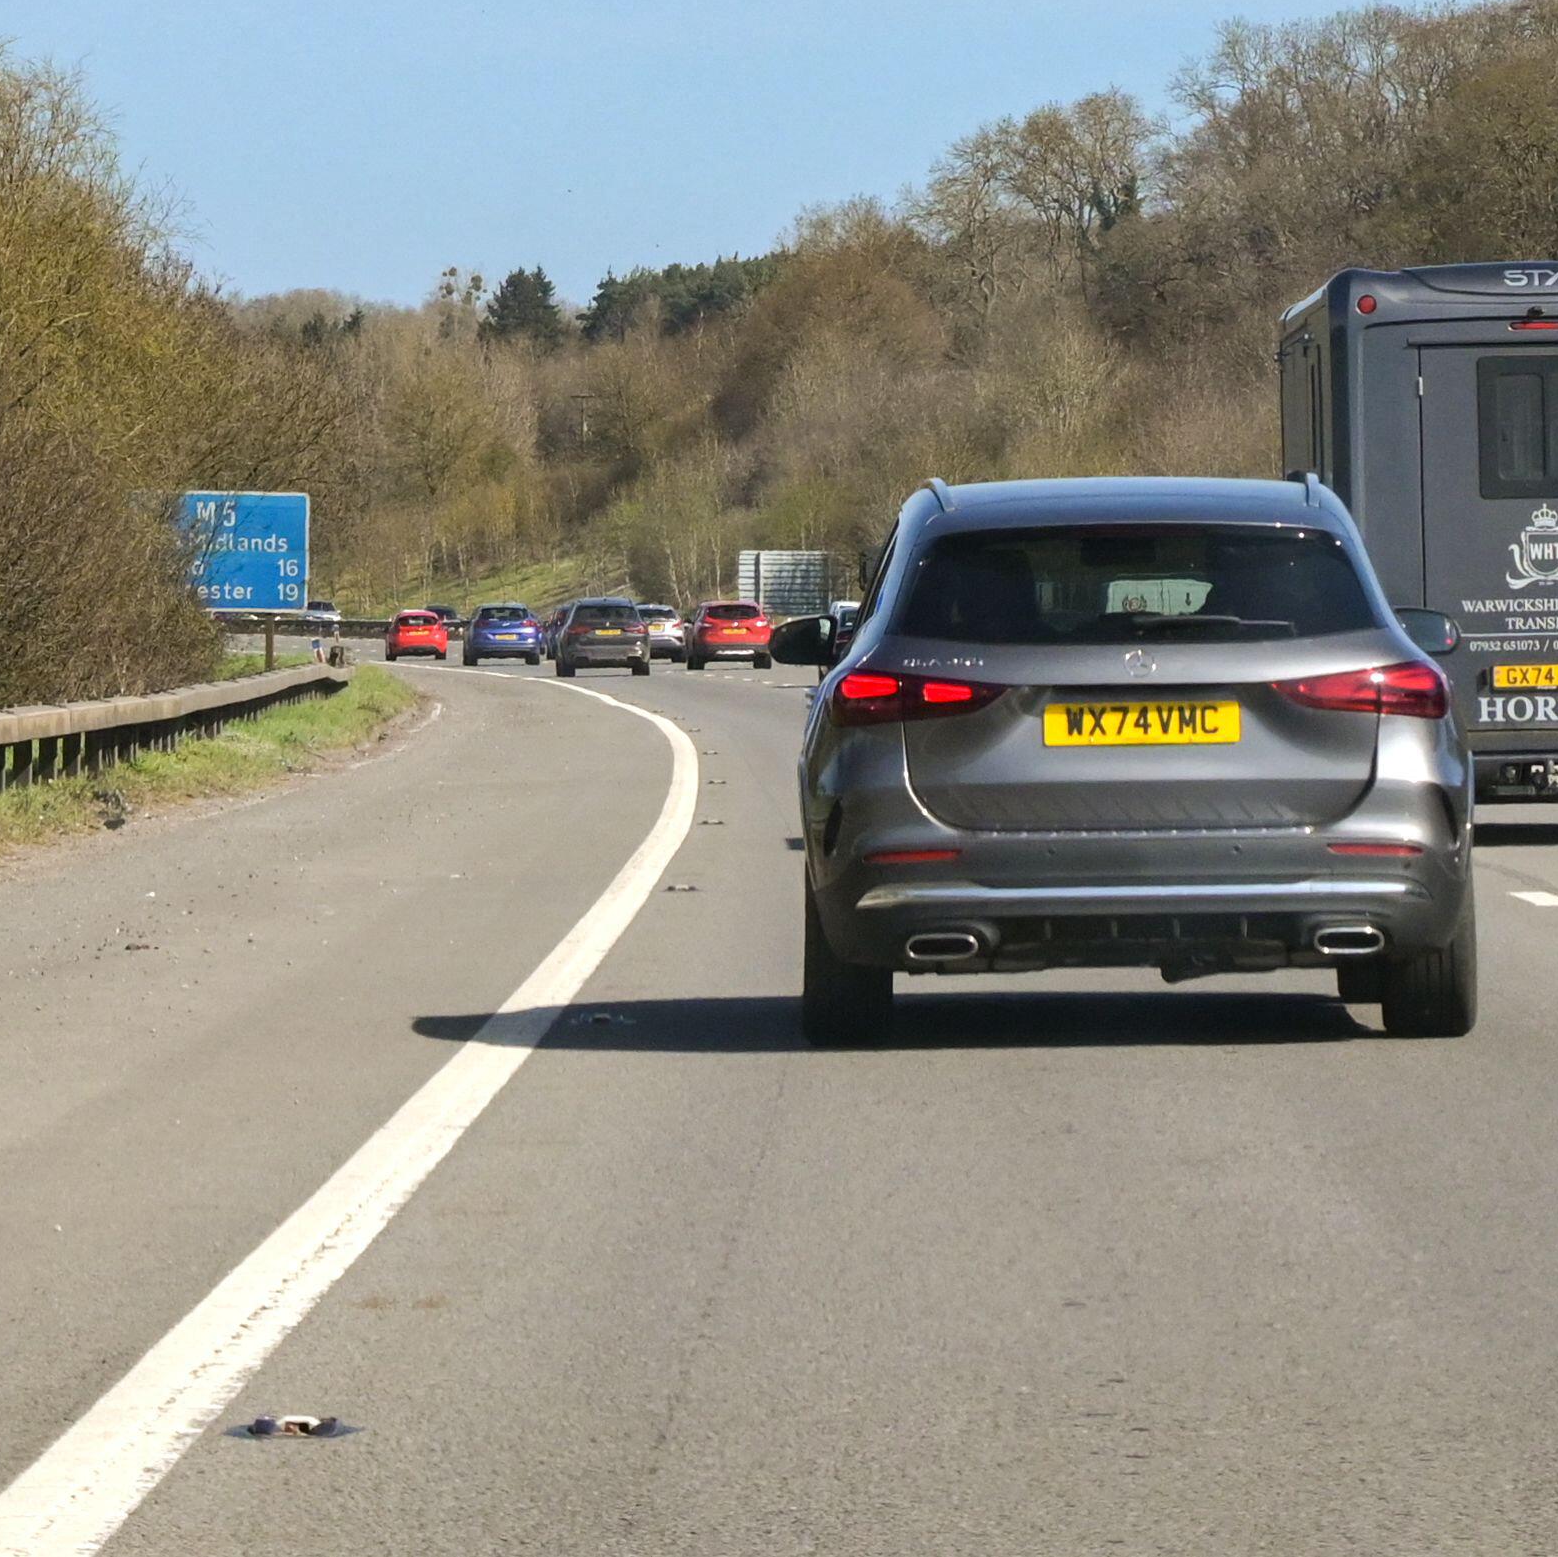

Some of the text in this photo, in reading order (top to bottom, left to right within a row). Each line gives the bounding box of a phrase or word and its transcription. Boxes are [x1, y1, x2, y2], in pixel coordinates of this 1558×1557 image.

[277, 558, 299, 577] 16
[277, 582, 299, 602] 19
[1506, 667, 1555, 685] GX74
